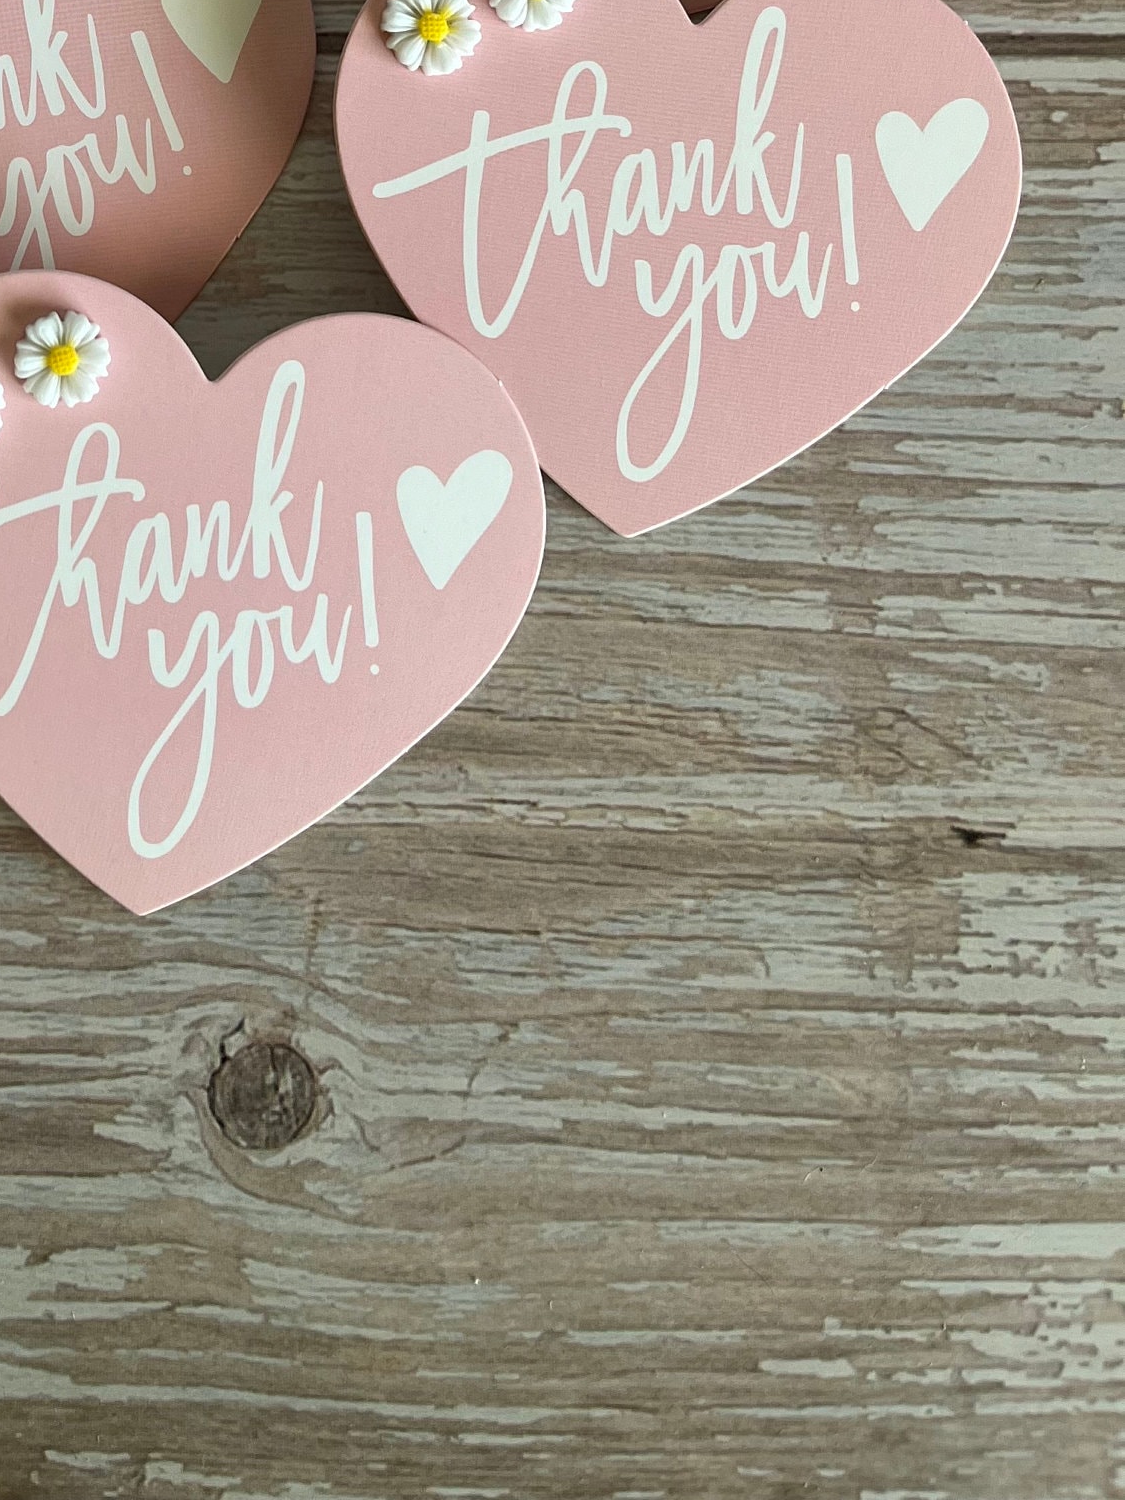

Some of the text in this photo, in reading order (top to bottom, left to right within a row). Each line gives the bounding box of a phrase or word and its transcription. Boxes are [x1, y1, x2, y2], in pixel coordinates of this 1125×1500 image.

[373, 5, 805, 339] thank
[616, 153, 860, 483] you!
[128, 511, 379, 858] you!
